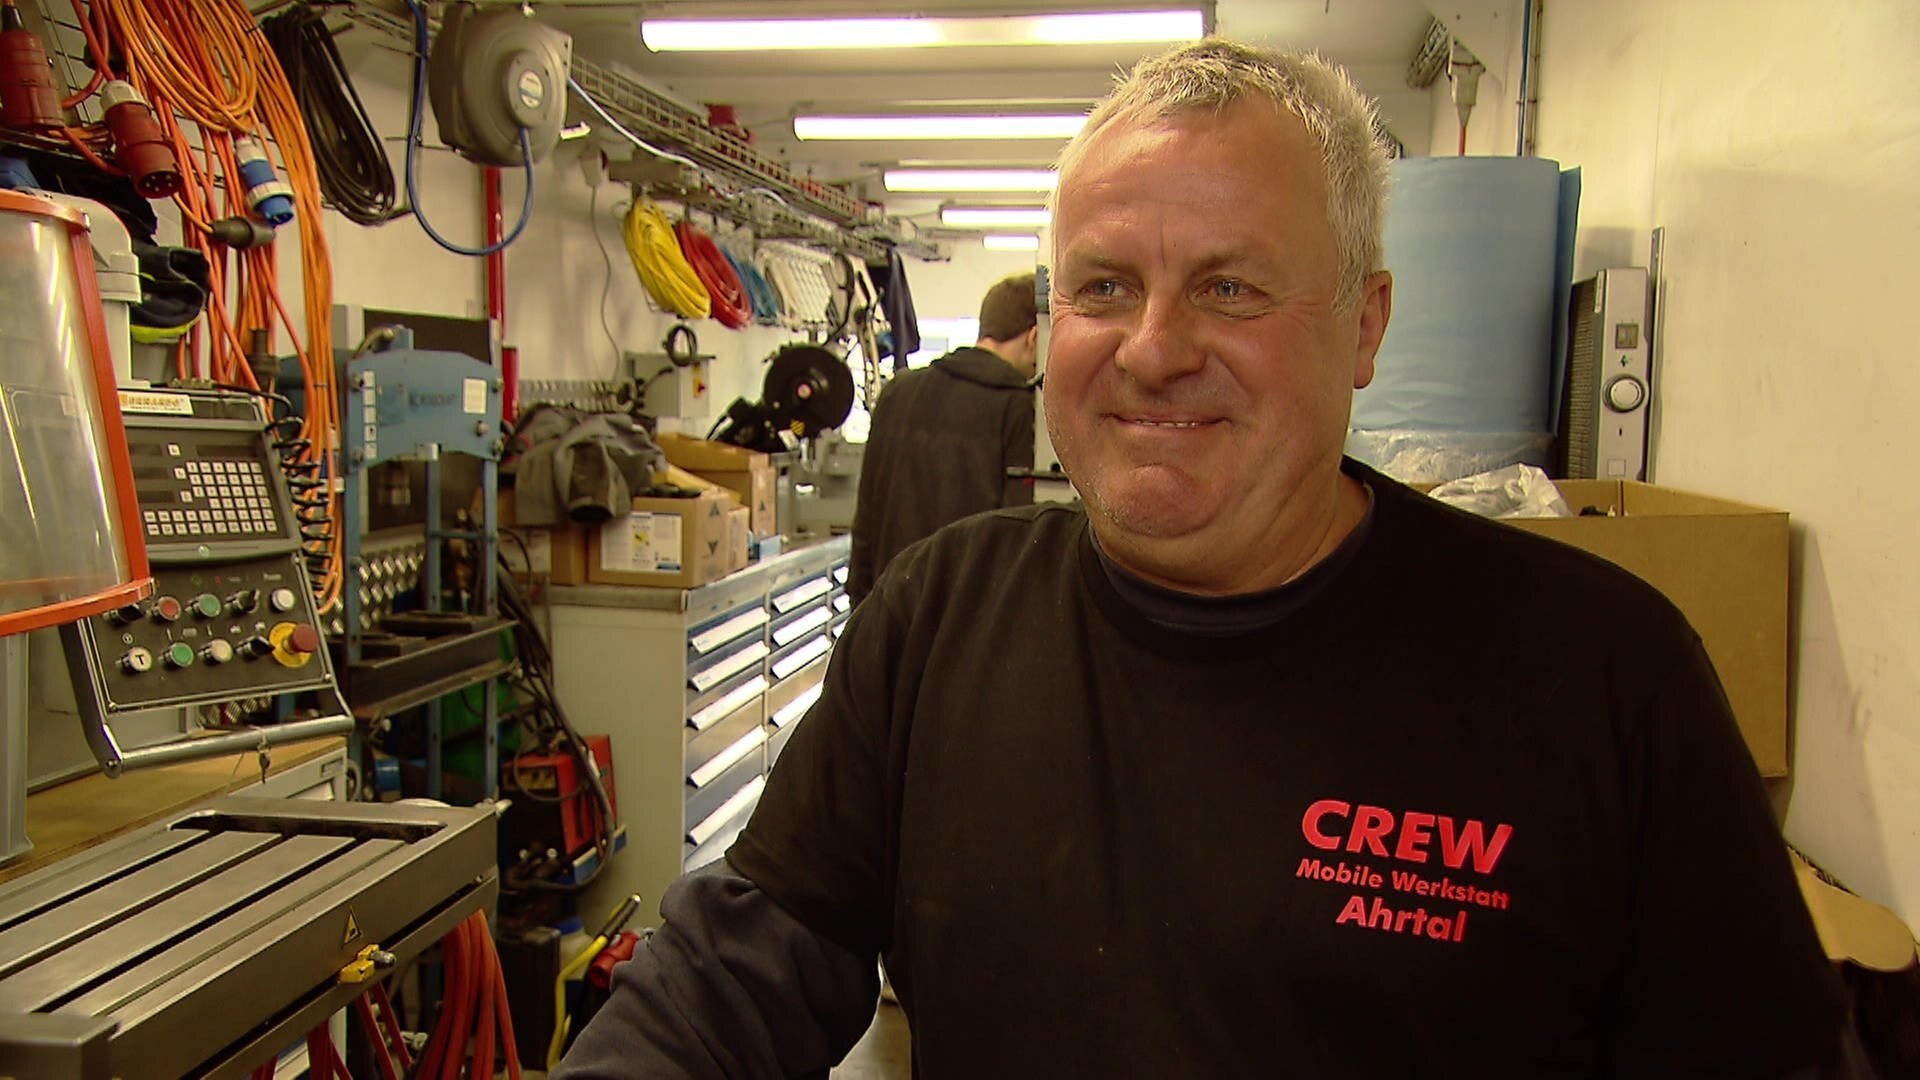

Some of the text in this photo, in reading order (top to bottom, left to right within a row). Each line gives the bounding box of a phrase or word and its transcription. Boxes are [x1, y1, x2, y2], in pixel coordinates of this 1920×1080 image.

[135, 654, 145, 665] T
[1302, 800, 1513, 874] CREW
[1296, 858, 1510, 910] Mobile Werkstatt
[1336, 895, 1467, 942] Ahrtal
